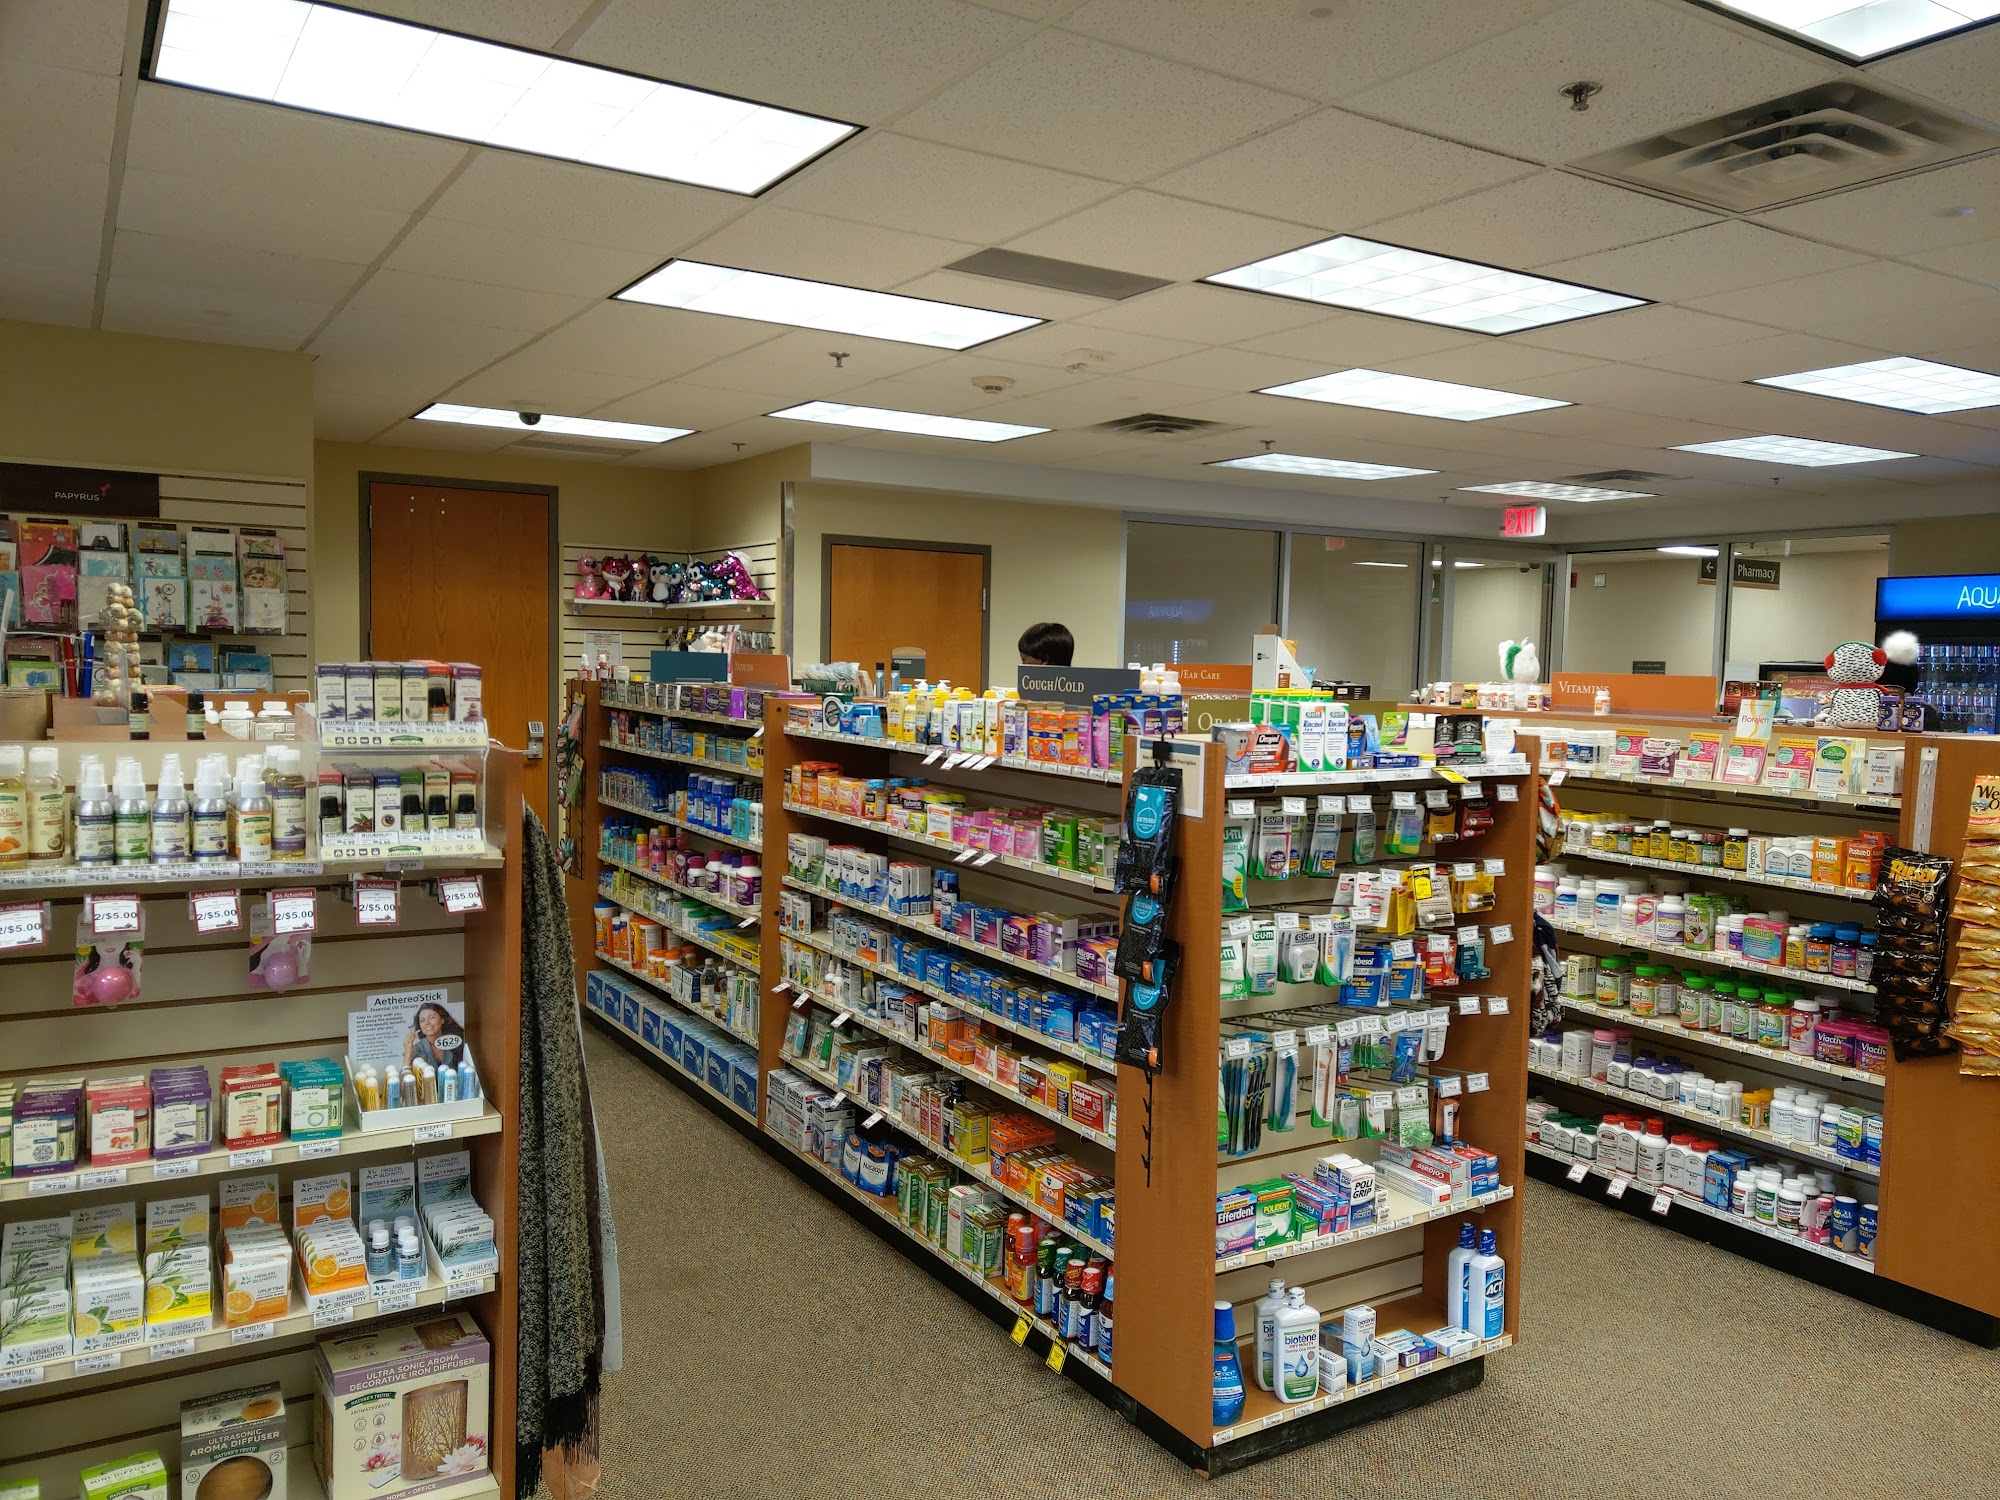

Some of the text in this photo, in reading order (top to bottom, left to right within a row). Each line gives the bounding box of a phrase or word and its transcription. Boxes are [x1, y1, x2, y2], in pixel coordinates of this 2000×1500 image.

[55, 491, 100, 501] PAPYRUS
[1505, 507, 1536, 536] EXIT
[1738, 564, 1776, 582] Pharmacy
[1201, 671, 1221, 680] CARE
[1559, 681, 1610, 694] VITAMINS
[1742, 715, 1769, 724] Florajen
[1259, 735, 1280, 743] Orajel
[1749, 844, 1757, 869] Fergon
[1816, 851, 1838, 861] IRON
[1889, 859, 1938, 883] RIESEN
[368, 882, 395, 890] Advertised
[204, 890, 234, 899] Advertised
[286, 890, 313, 898] Advertised
[446, 891, 480, 901] 2/$5.00
[359, 904, 396, 913] 2/$5.00
[94, 911, 138, 921] 2/$5.00
[197, 909, 238, 921] 2/$5.00
[275, 910, 314, 921] 2/$5.00
[1077, 948, 1095, 960] Allegra
[931, 1008, 946, 1017] ZICAM
[1818, 1033, 1843, 1045] Viactiv
[1072, 1088, 1092, 1102] Dristan
[1073, 1095, 1085, 1106] Cold
[863, 1162, 885, 1175] Nasacort
[1417, 1163, 1445, 1179] Colgate
[1355, 1179, 1373, 1191] POLI
[1353, 1188, 1372, 1199] GRIP
[1263, 1201, 1291, 1213] POLIDENT
[1218, 1208, 1254, 1224] Efferdent
[181, 1282, 209, 1291] SOOTHING
[1486, 1281, 1503, 1296] ACT
[1284, 1333, 1317, 1345] biotène
[367, 1354, 459, 1381] ULTRA SONIC AROMA
[349, 1357, 475, 1392] DECORATIVE IRON DIFFUSER
[351, 1402, 391, 1416] AROMATHERAPY
[208, 1428, 263, 1446] ULTRASONIC
[189, 1431, 281, 1458] AROMA DIFFUSER
[90, 1461, 158, 1485] MINI DIFFUSER
[386, 1483, 437, 1500] HOME OFFICE
